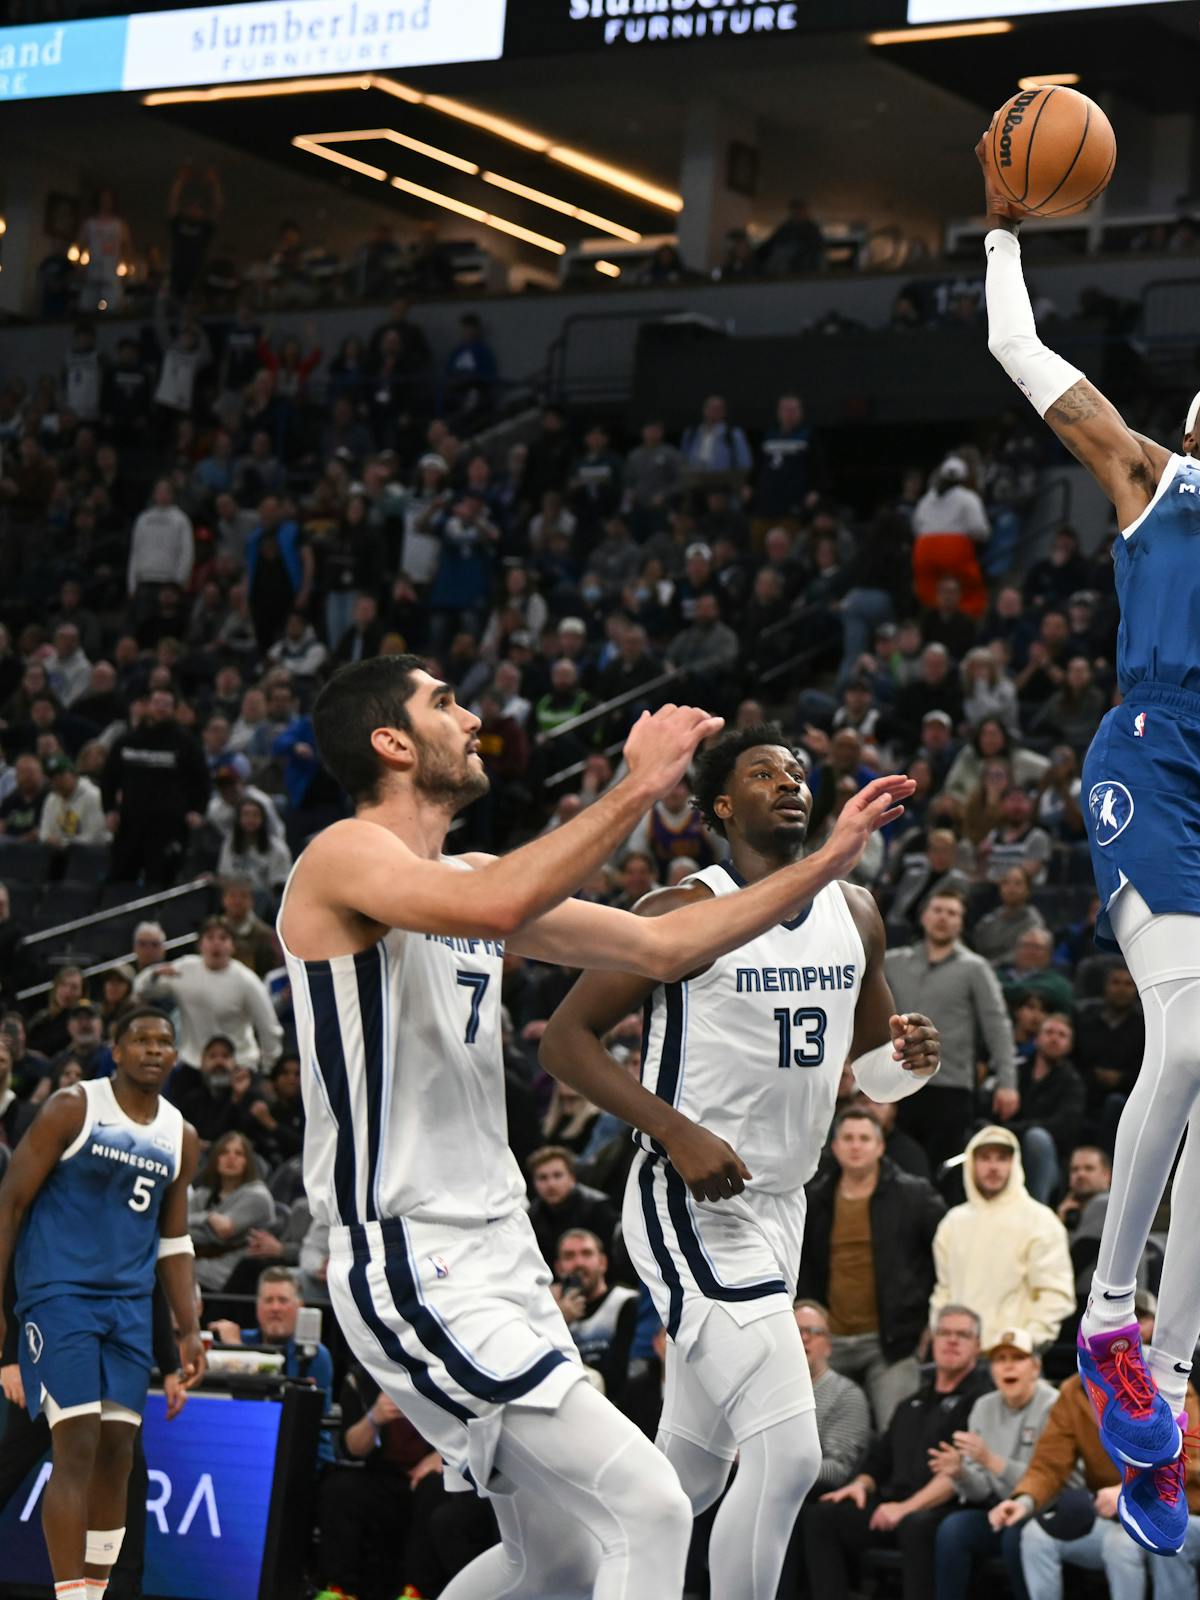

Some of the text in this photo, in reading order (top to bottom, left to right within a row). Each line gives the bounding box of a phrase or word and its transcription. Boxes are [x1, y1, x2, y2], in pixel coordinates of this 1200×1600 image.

[192, 0, 431, 51] slumberland
[603, 4, 799, 45] FURNITURE
[1000, 89, 1043, 168] Wilson
[736, 965, 855, 992] MEMPHIS
[456, 968, 491, 1044] 7
[774, 1007, 828, 1068] 13
[92, 1143, 169, 1178] MINNESOTA
[128, 1176, 156, 1212] 5
[19, 1461, 221, 1538] ARA
